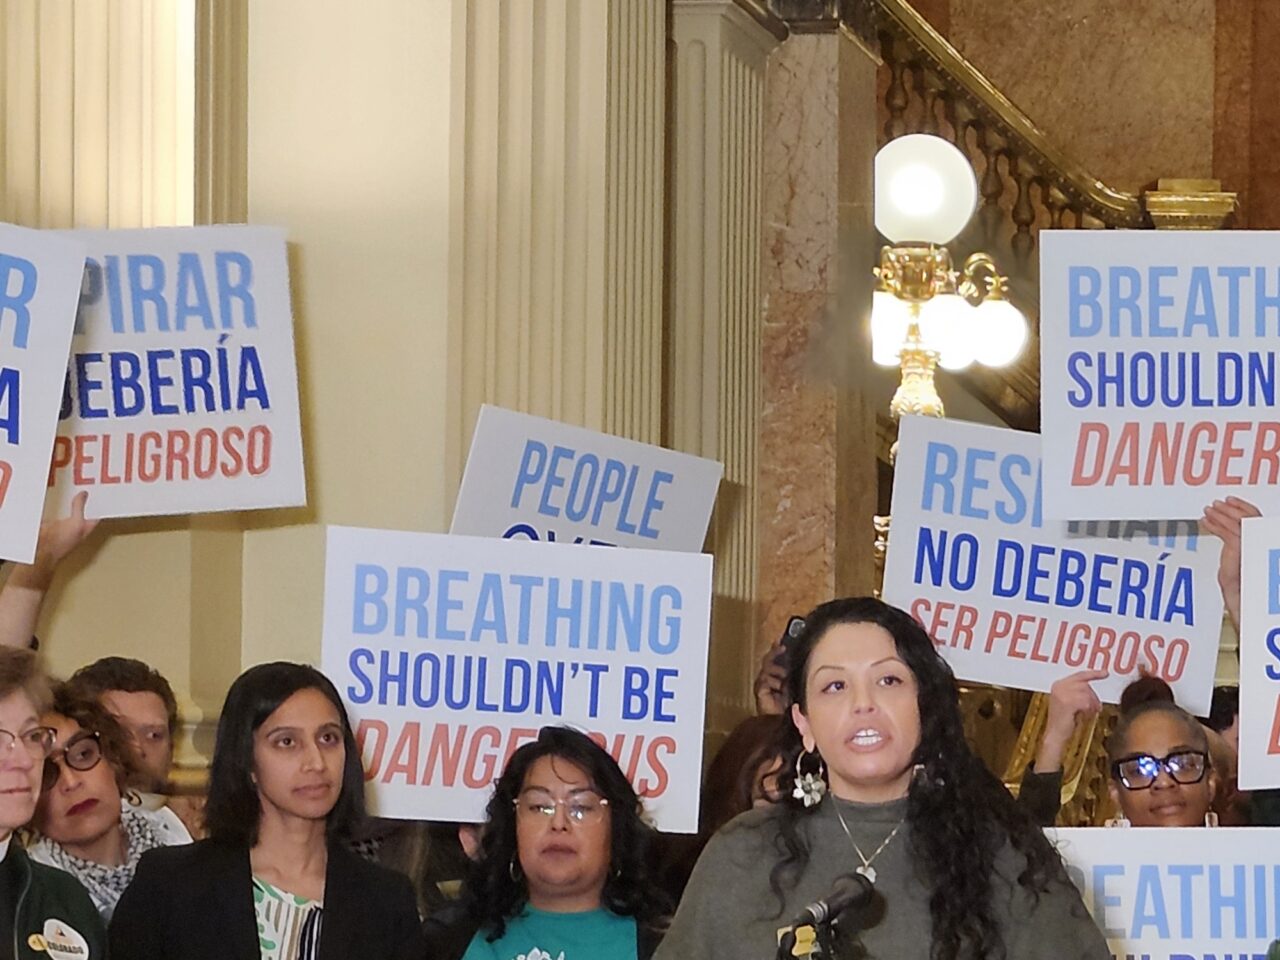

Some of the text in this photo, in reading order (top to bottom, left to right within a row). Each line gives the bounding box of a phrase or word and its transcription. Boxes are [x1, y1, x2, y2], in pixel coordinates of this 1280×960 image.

[73, 251, 260, 336] PIRAR
[48, 424, 273, 488] PELIGROSO
[510, 438, 674, 540] PEOPLE
[351, 563, 683, 656] BREATHING
[913, 526, 1195, 627] NO DEBERÍA
[910, 597, 1190, 682] SER PELIGROSO
[346, 647, 680, 724] SHOULDN'T BE
